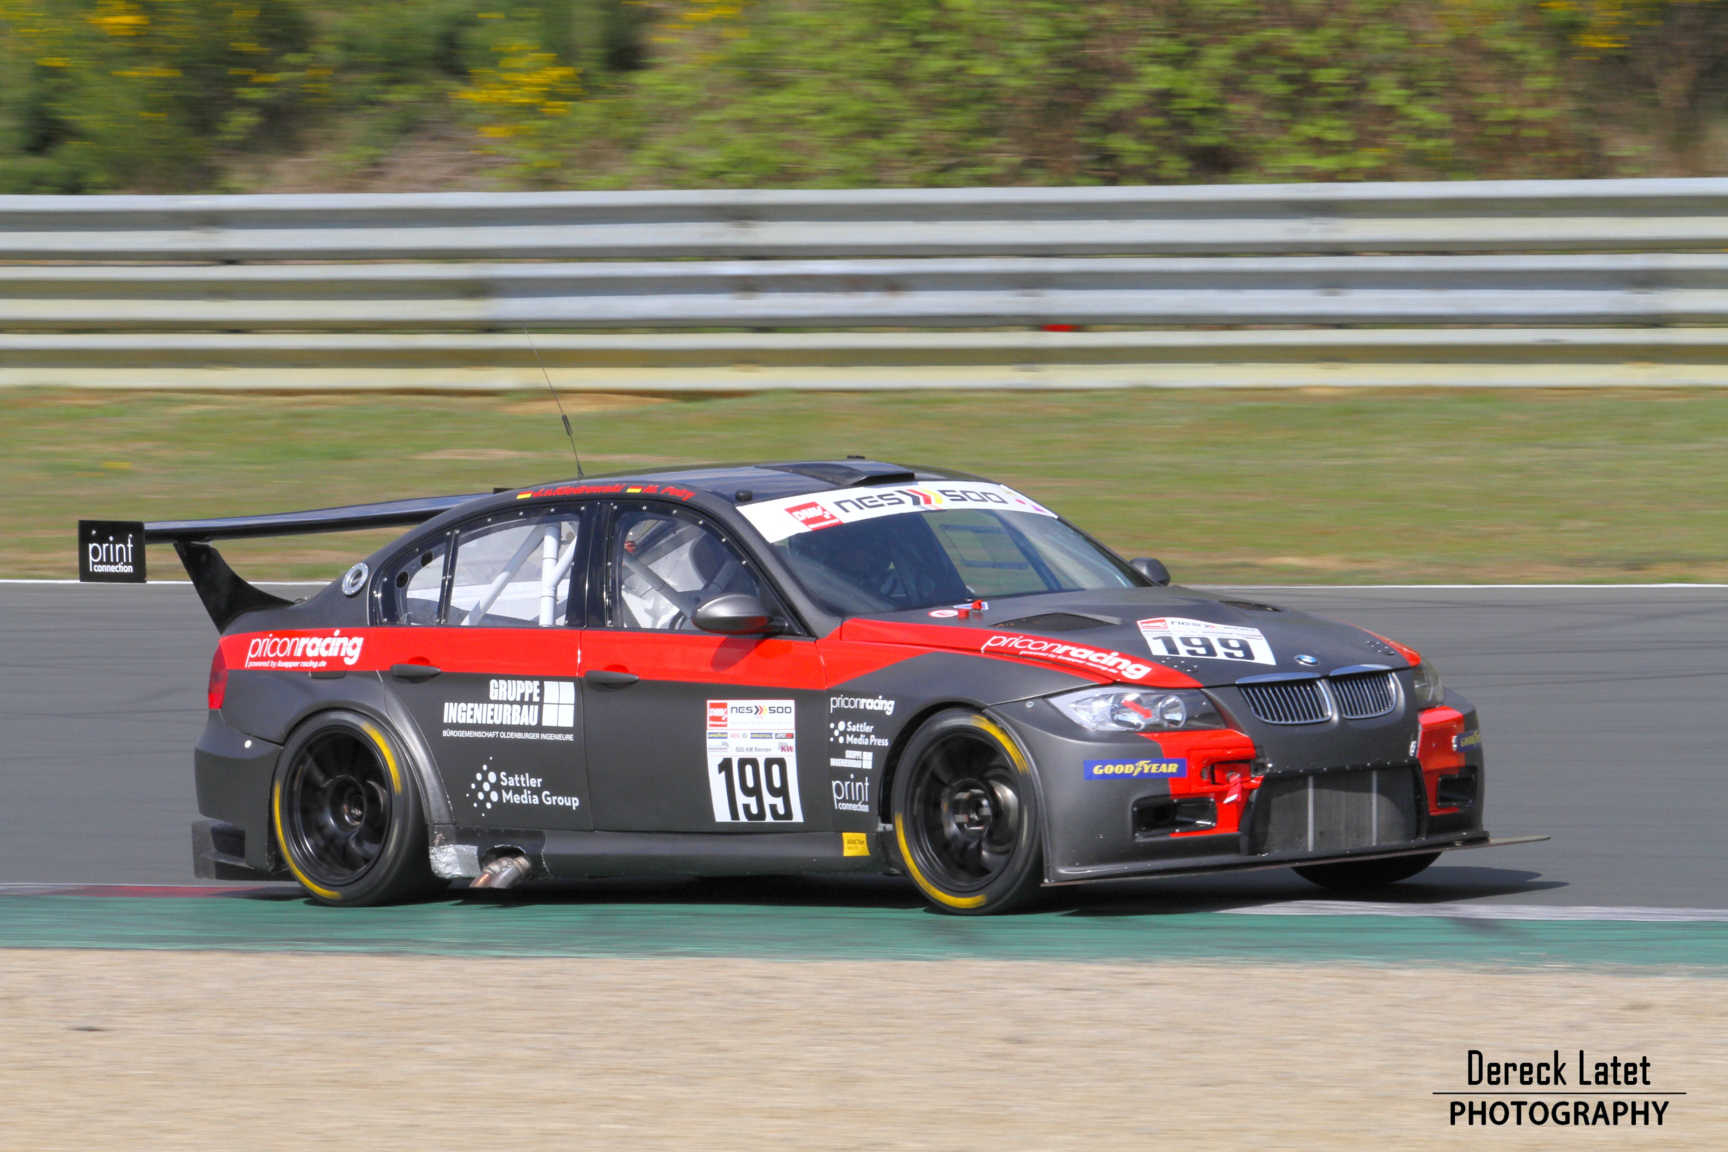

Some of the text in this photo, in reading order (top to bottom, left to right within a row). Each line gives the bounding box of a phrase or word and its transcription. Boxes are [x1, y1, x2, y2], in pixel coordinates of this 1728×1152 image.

[940, 490, 1008, 504] 500
[88, 534, 134, 572] print
[93, 563, 134, 573] connection
[245, 629, 364, 668] priconracing
[981, 634, 1152, 680] priconracing
[1152, 635, 1256, 661] 199
[489, 679, 540, 702] GRUPPE
[443, 702, 539, 726] INGENIEURBAU
[768, 706, 792, 714] 500
[830, 695, 895, 715] priconracing
[846, 721, 874, 733] Sattler
[846, 734, 889, 746] Media Press
[1092, 760, 1179, 776] GOODYEAR
[500, 771, 542, 788] Sattler
[717, 757, 794, 821] 199
[501, 789, 580, 810] Media Group
[832, 773, 870, 810] print
